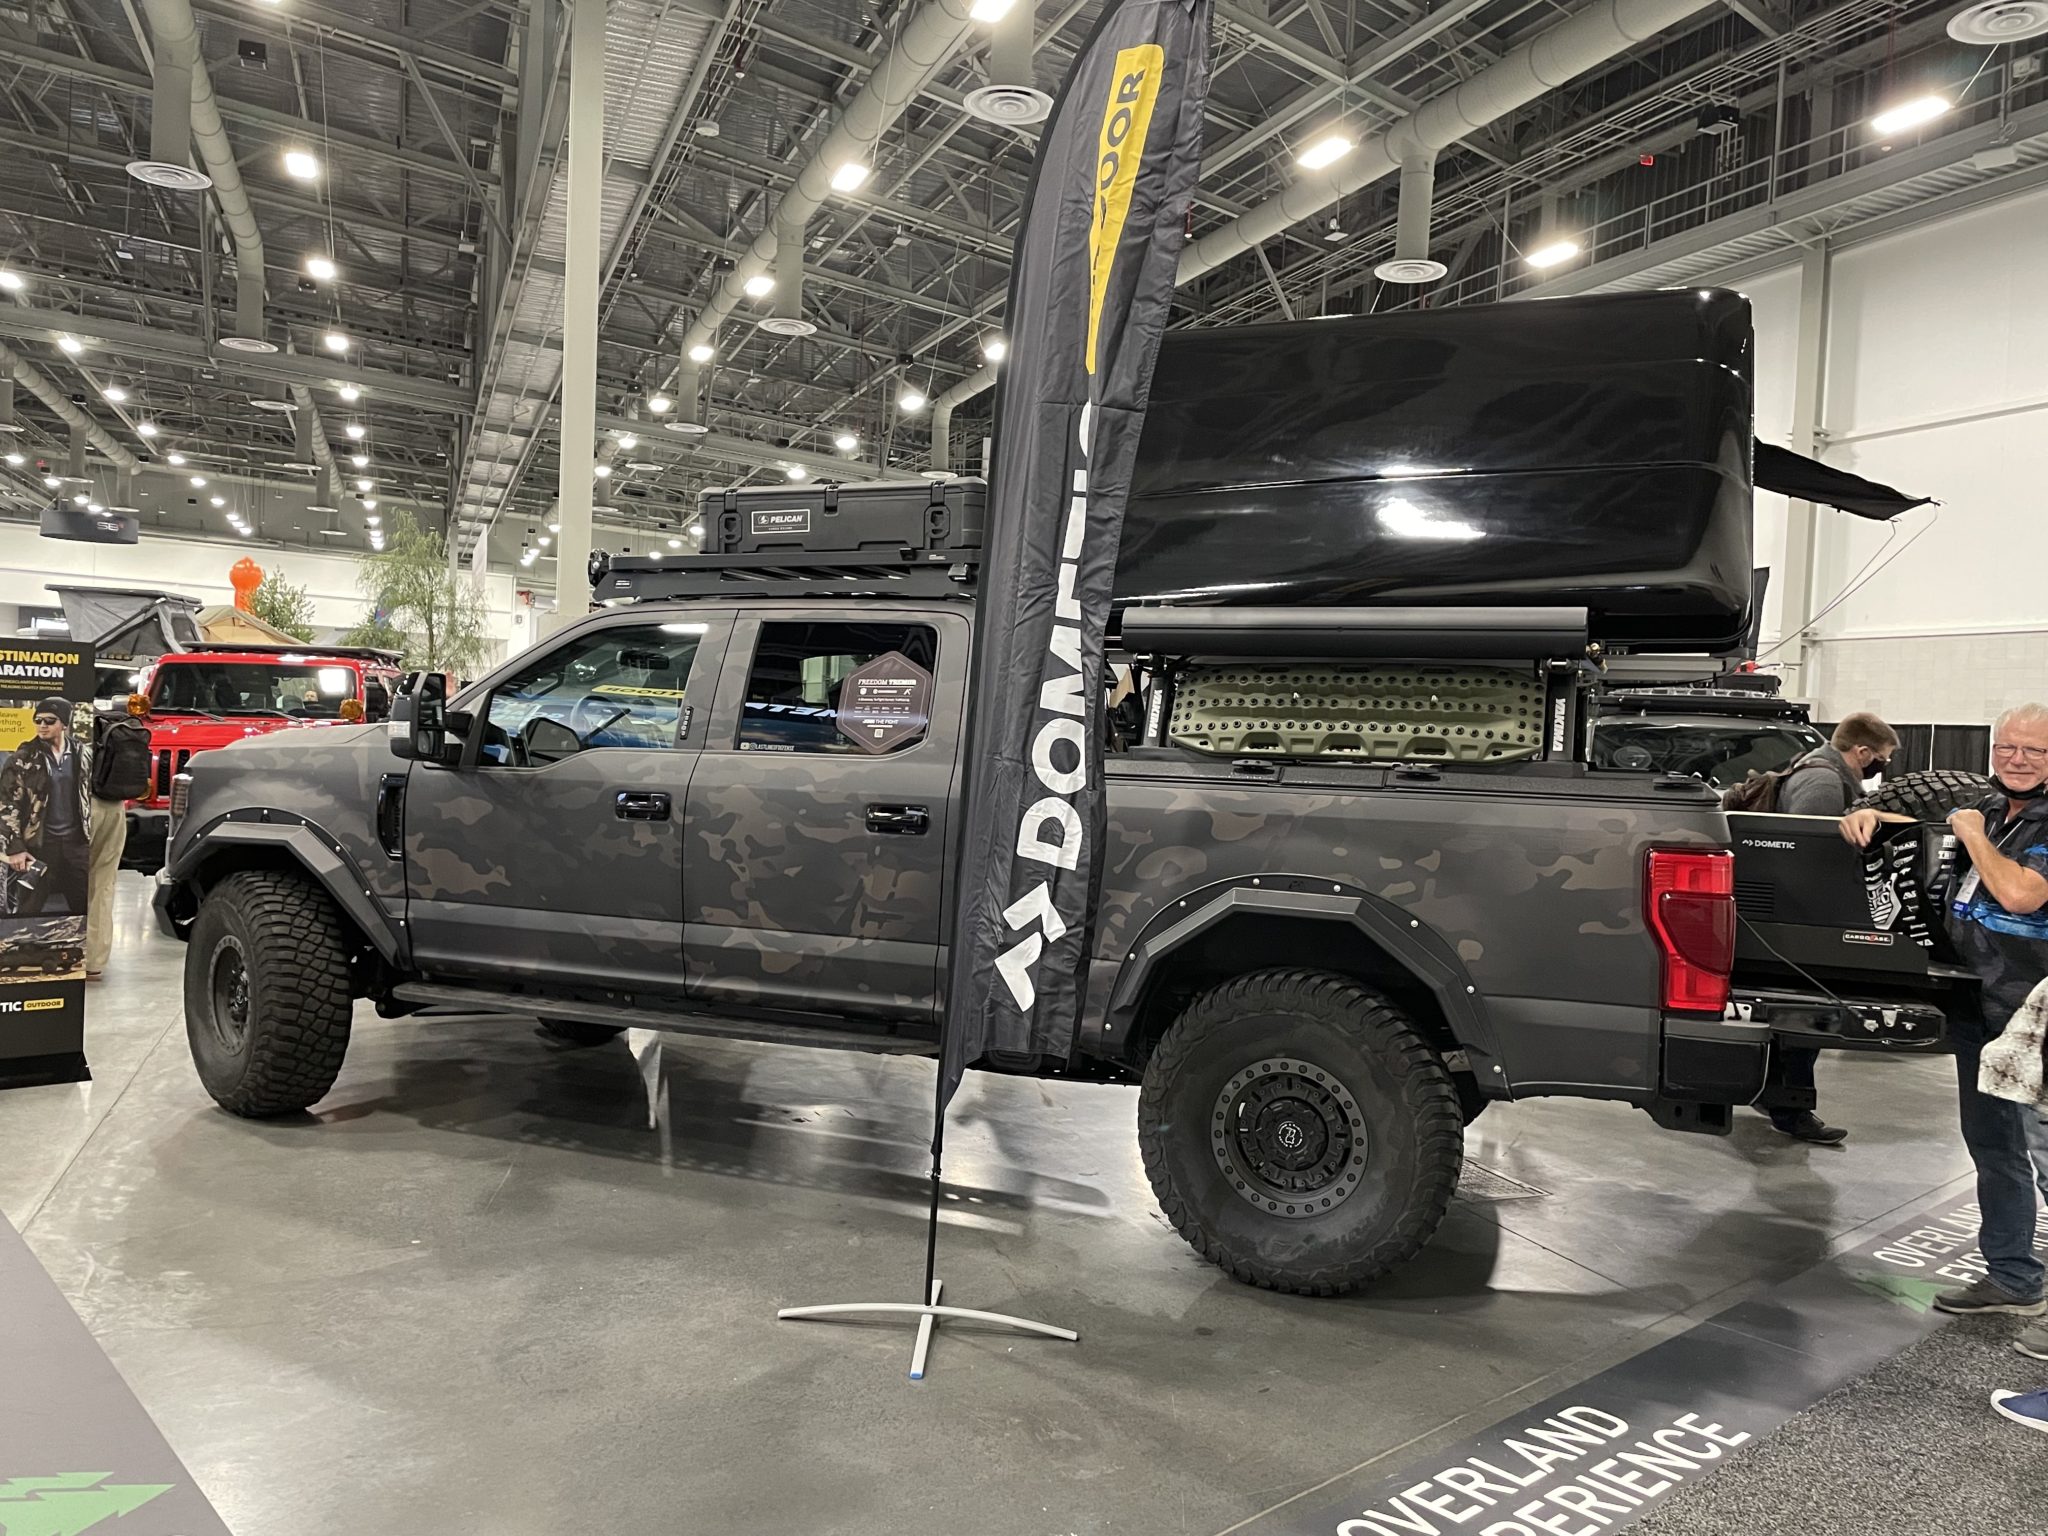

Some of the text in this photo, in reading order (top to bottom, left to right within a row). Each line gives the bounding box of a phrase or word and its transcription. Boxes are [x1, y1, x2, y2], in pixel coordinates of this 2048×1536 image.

[770, 515, 803, 523] PELICAN
[1148, 690, 1163, 738] YAKIMA
[1552, 698, 1566, 751] YAKIMA
[1754, 839, 1796, 849] DOMETIC
